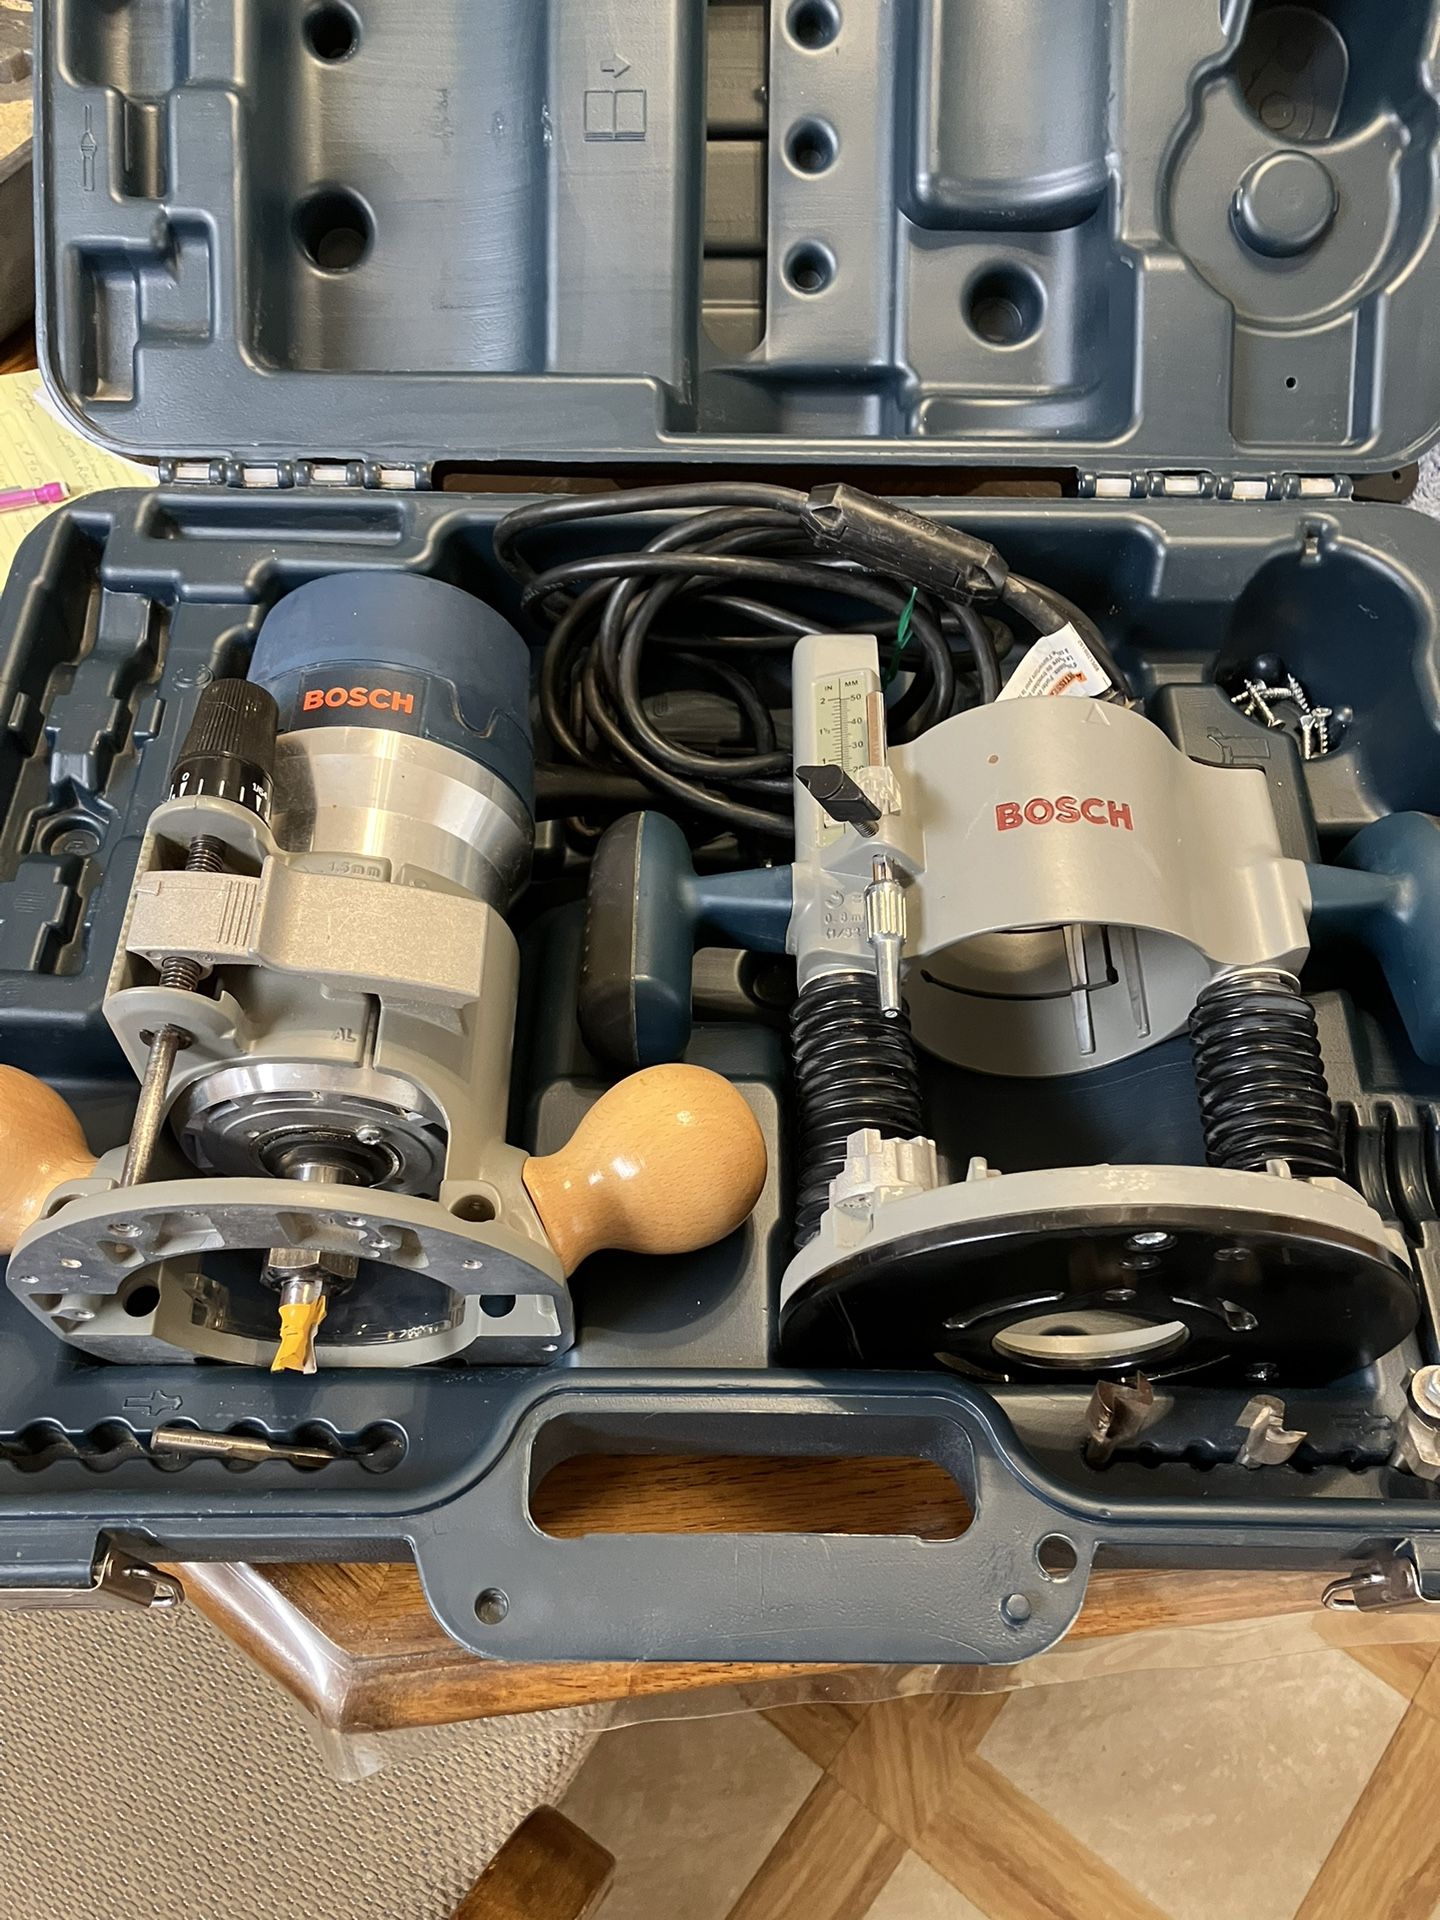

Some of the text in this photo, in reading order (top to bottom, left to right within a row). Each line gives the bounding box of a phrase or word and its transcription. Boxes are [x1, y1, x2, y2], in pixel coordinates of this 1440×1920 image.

[303, 687, 414, 714] BOSCH
[850, 693, 861, 702] 50
[851, 740, 863, 749] 30
[182, 772, 190, 781] 0
[996, 796, 1133, 831] BOSCH
[334, 1027, 356, 1042] AL
